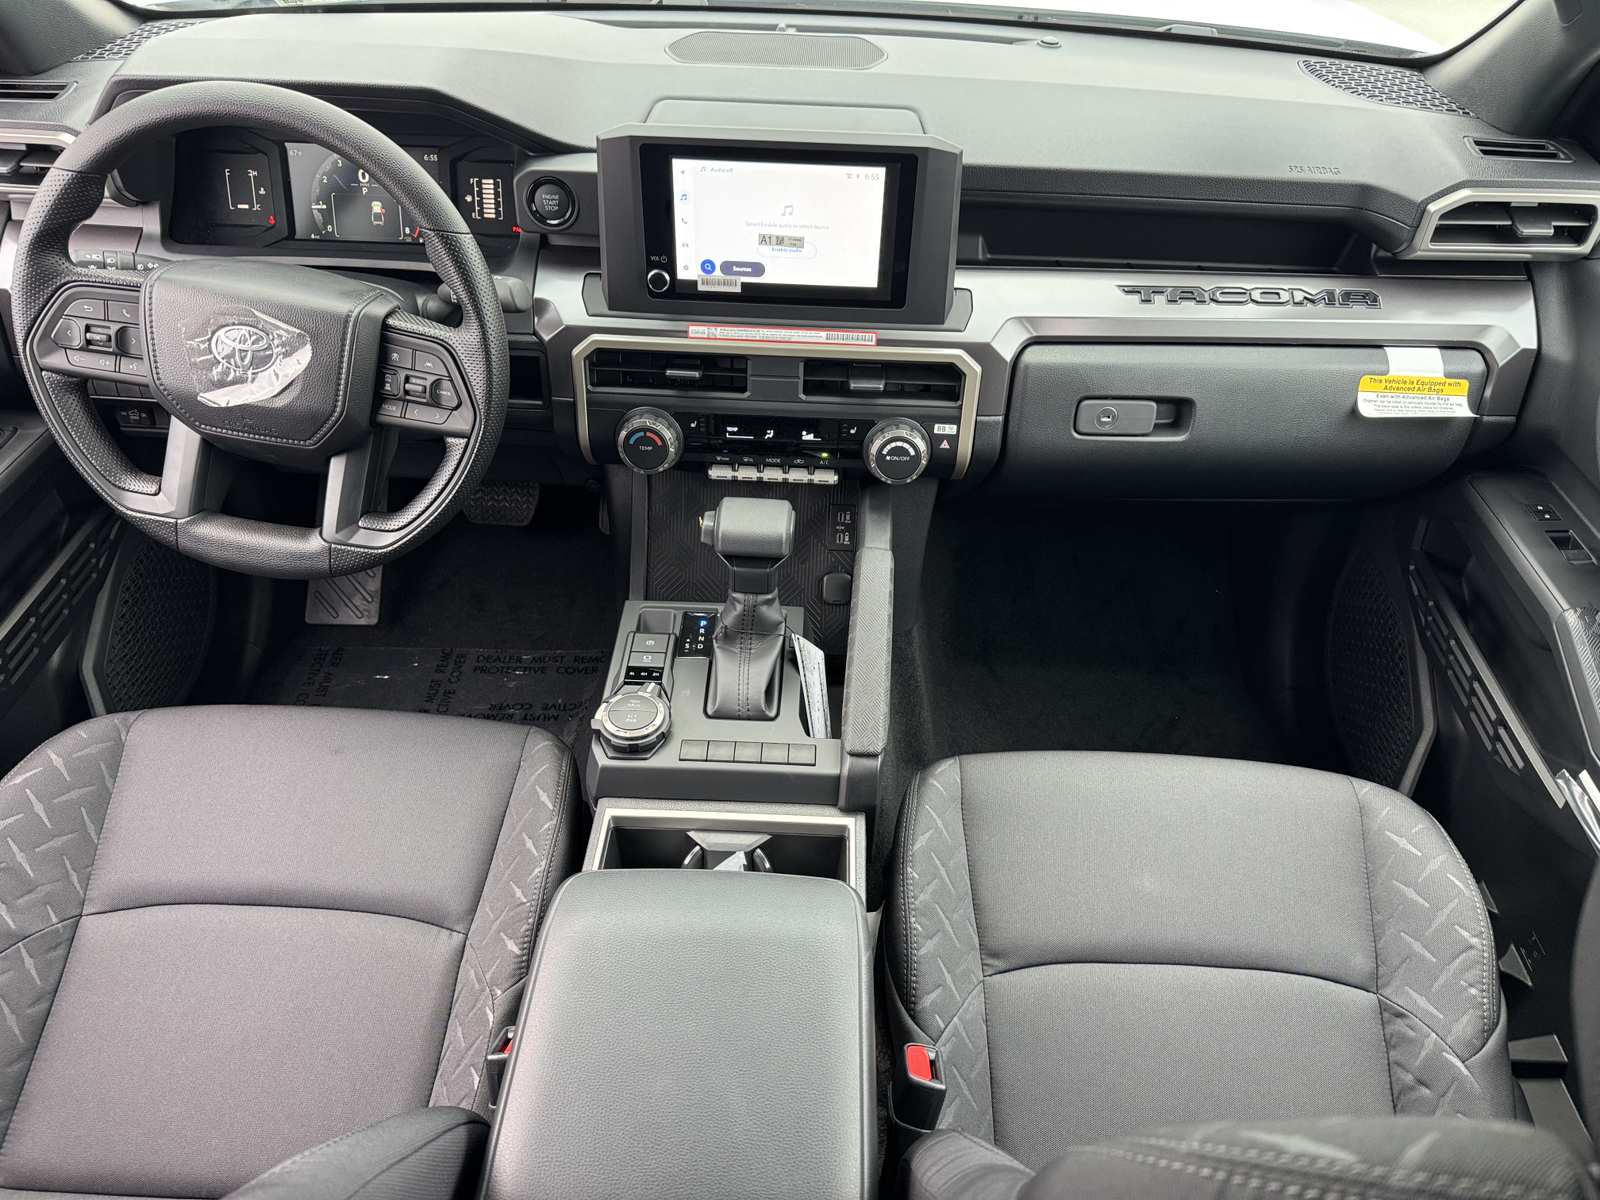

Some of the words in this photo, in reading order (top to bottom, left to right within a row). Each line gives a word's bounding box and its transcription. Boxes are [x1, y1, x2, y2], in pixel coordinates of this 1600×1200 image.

[423, 154, 438, 162] 6:55
[337, 159, 343, 167] 3
[1307, 165, 1341, 176] AIRBAG
[362, 187, 368, 196] P
[327, 224, 333, 232] 0
[404, 226, 410, 234] 8
[760, 235, 772, 245] A1
[1114, 284, 1383, 310] TACOMA
[1415, 379, 1447, 388] Equipped
[1427, 386, 1444, 394] Bags
[476, 654, 523, 664] DEALER
[530, 655, 566, 664] MUST
[448, 653, 468, 684] COVER
[473, 665, 548, 675] PROTECTIVE
[556, 666, 599, 675] COVER
[424, 678, 443, 704] MUST
[488, 702, 533, 711] COVER
